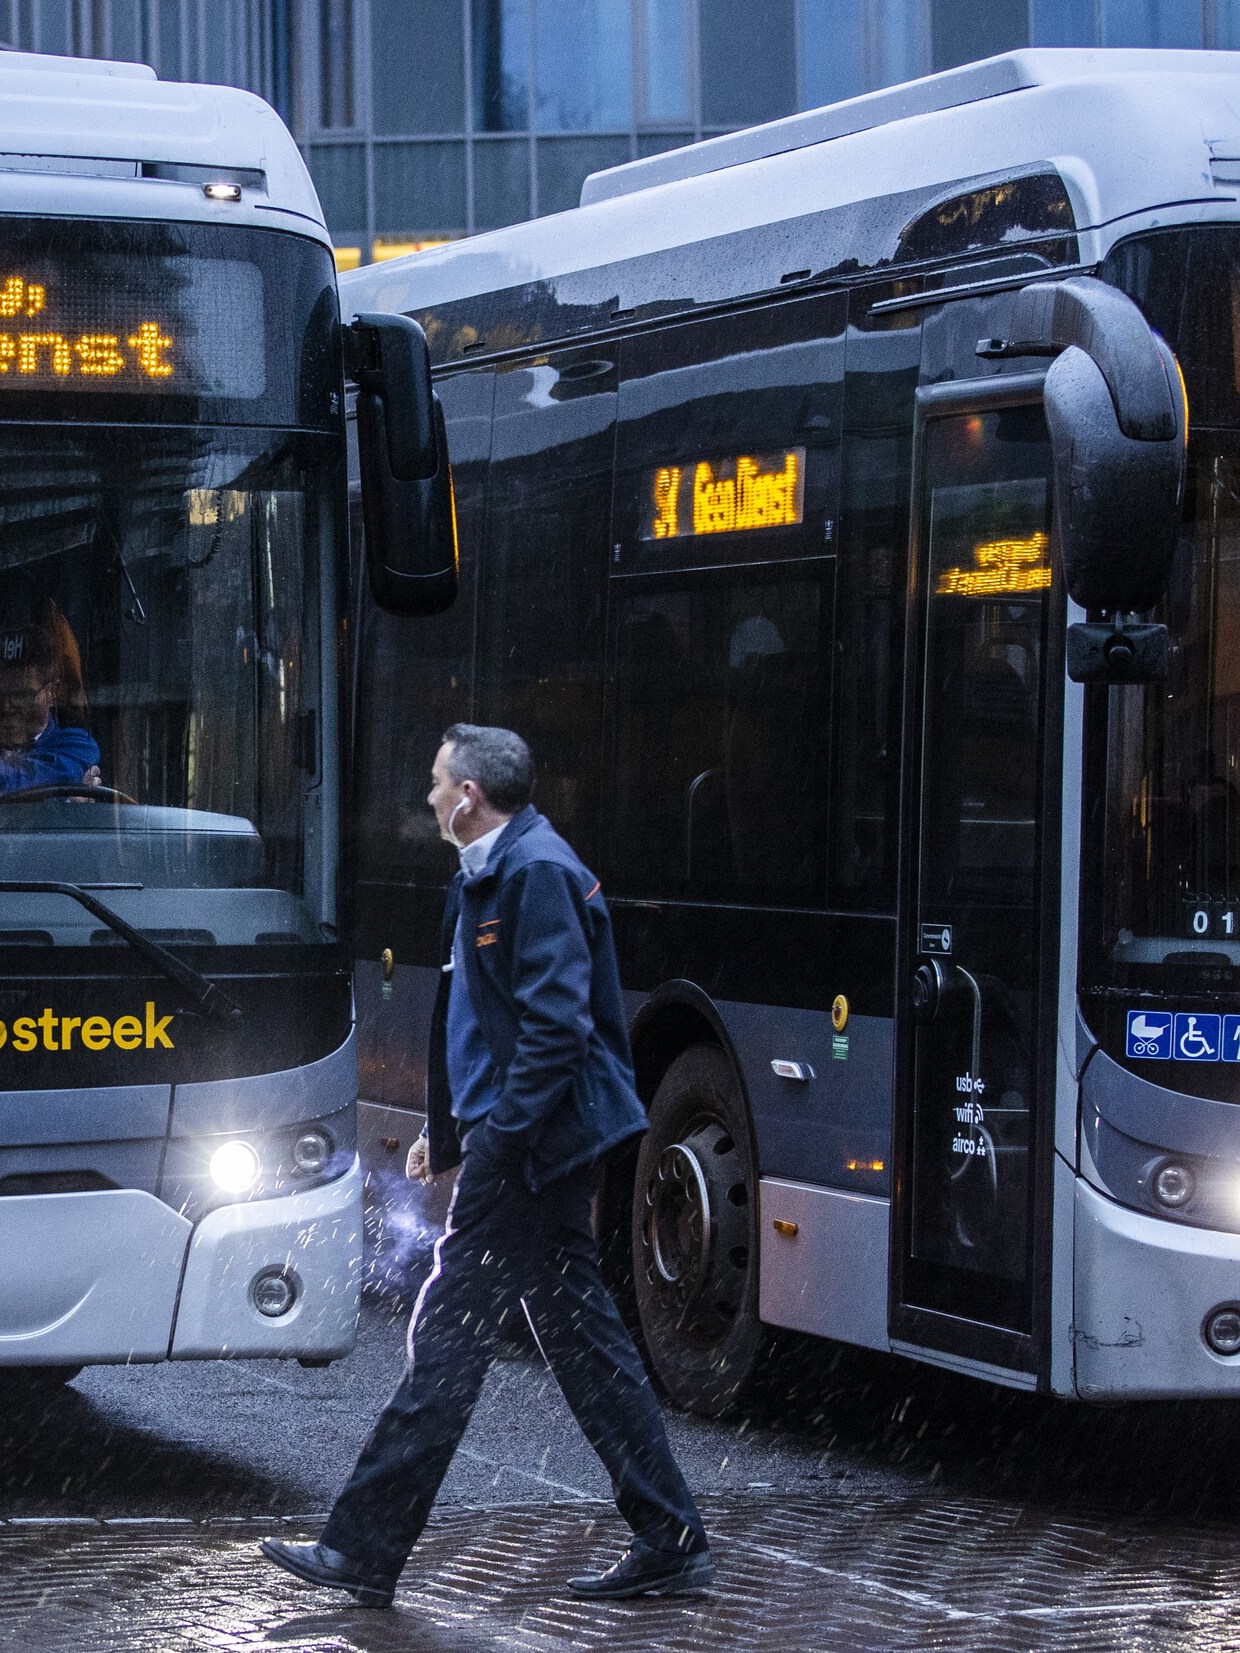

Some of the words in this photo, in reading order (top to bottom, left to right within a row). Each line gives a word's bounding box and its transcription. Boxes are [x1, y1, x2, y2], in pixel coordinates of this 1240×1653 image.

[12, 1001, 175, 1051] streek
[956, 1071, 973, 1093] usb
[956, 1102, 974, 1124] wifi
[952, 1131, 975, 1155] airco
